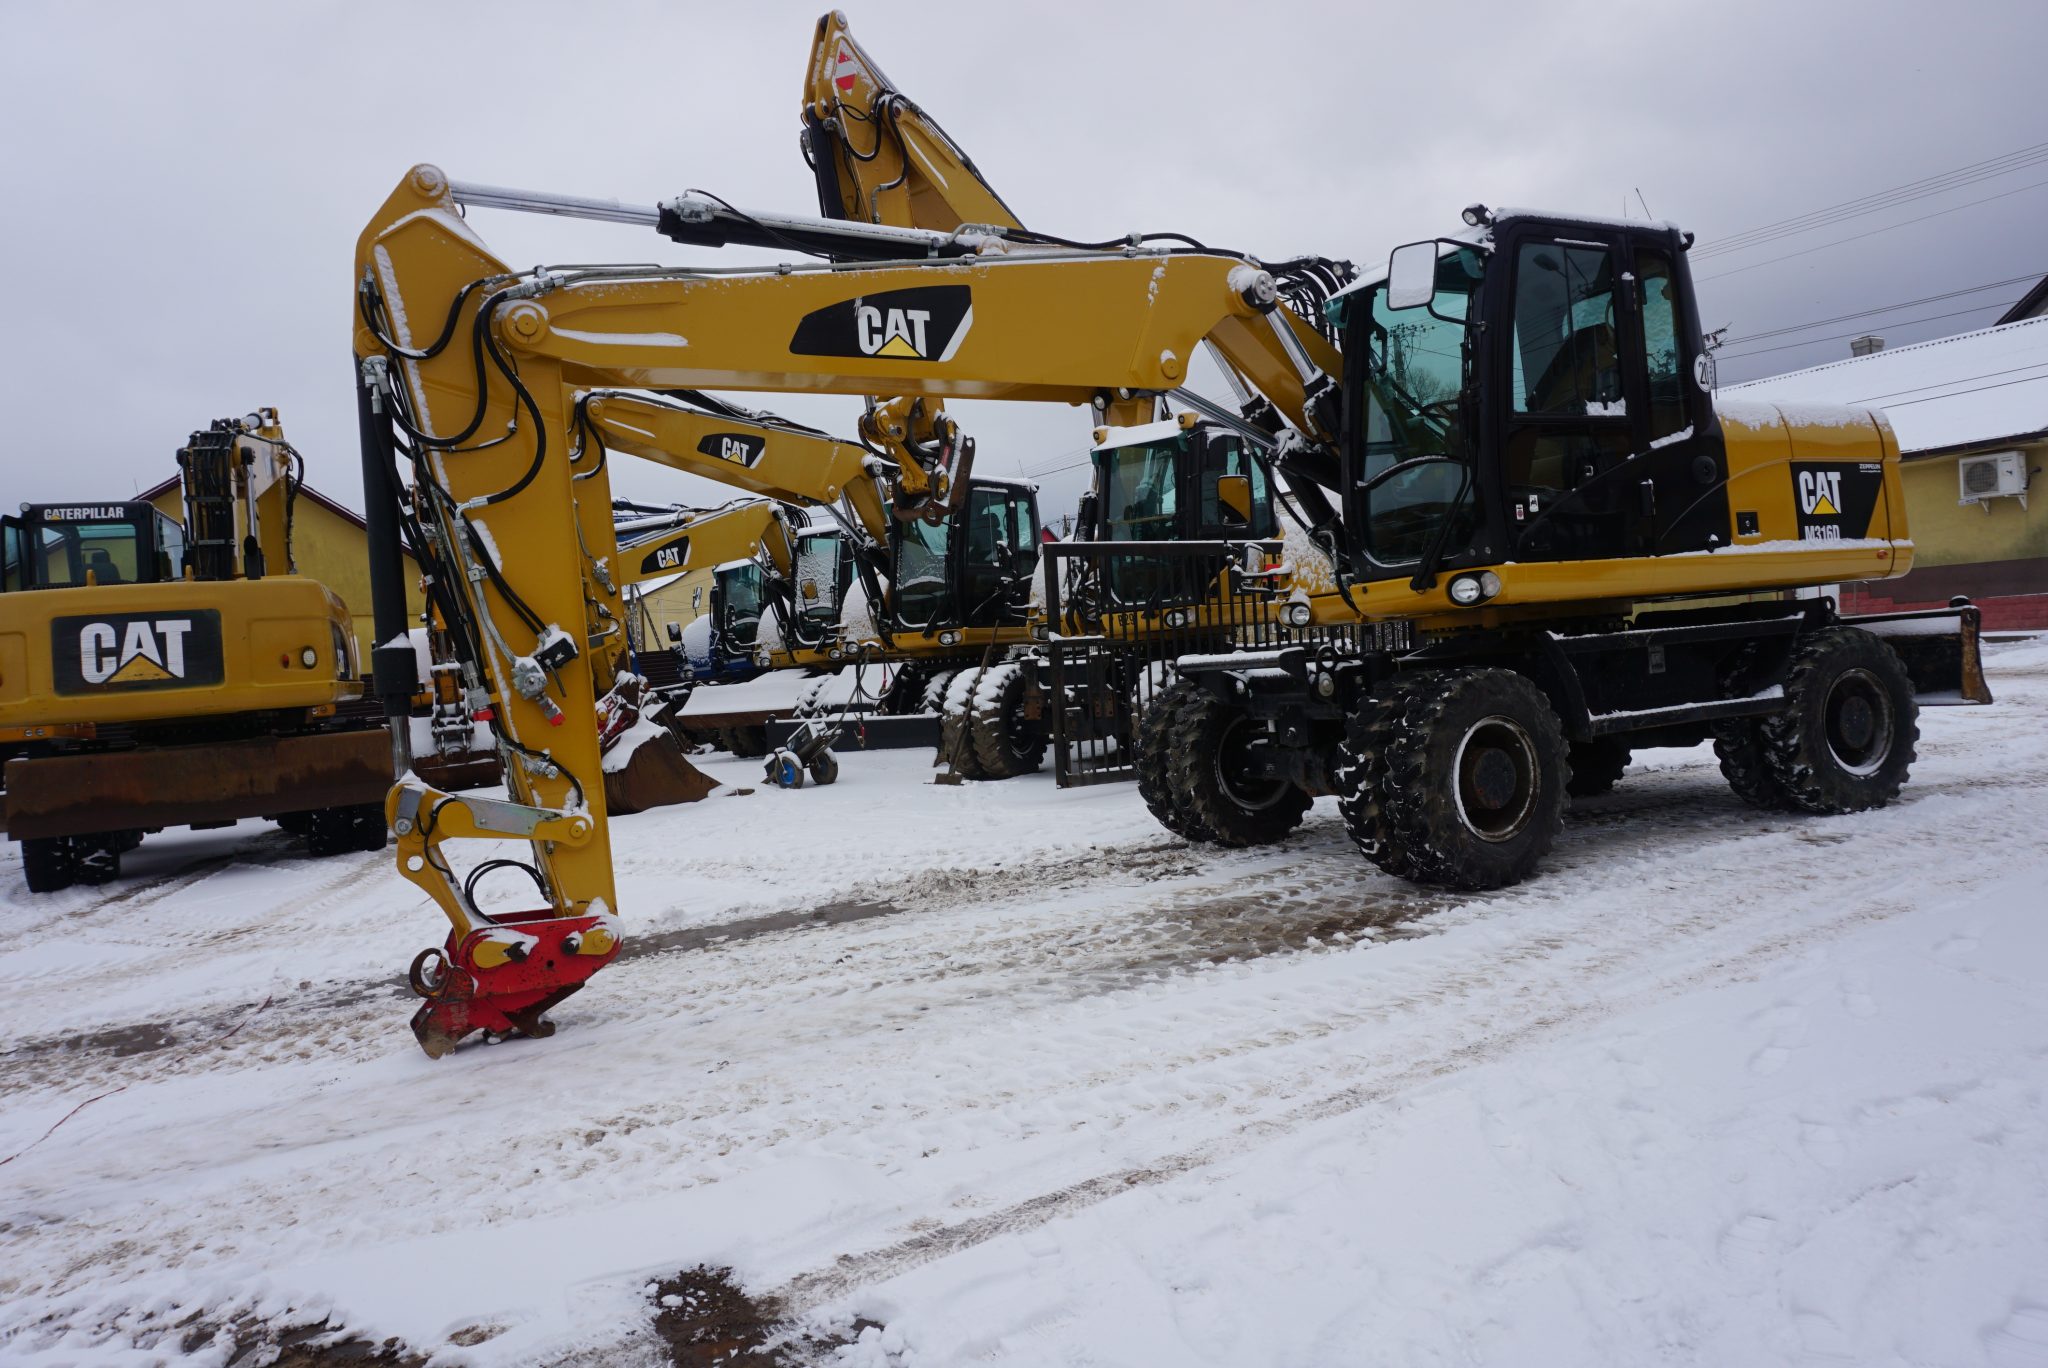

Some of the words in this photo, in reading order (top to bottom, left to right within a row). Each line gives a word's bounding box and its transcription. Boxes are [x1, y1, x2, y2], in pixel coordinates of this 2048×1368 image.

[858, 305, 930, 357] CAT
[1699, 361, 1709, 385] 20
[721, 437, 749, 465] CAT
[1798, 471, 1841, 514] CAT
[44, 507, 124, 520] CATERPILLAR
[1804, 525, 1840, 540] M316D
[657, 547, 680, 568] CAT
[80, 619, 191, 684] CAT
